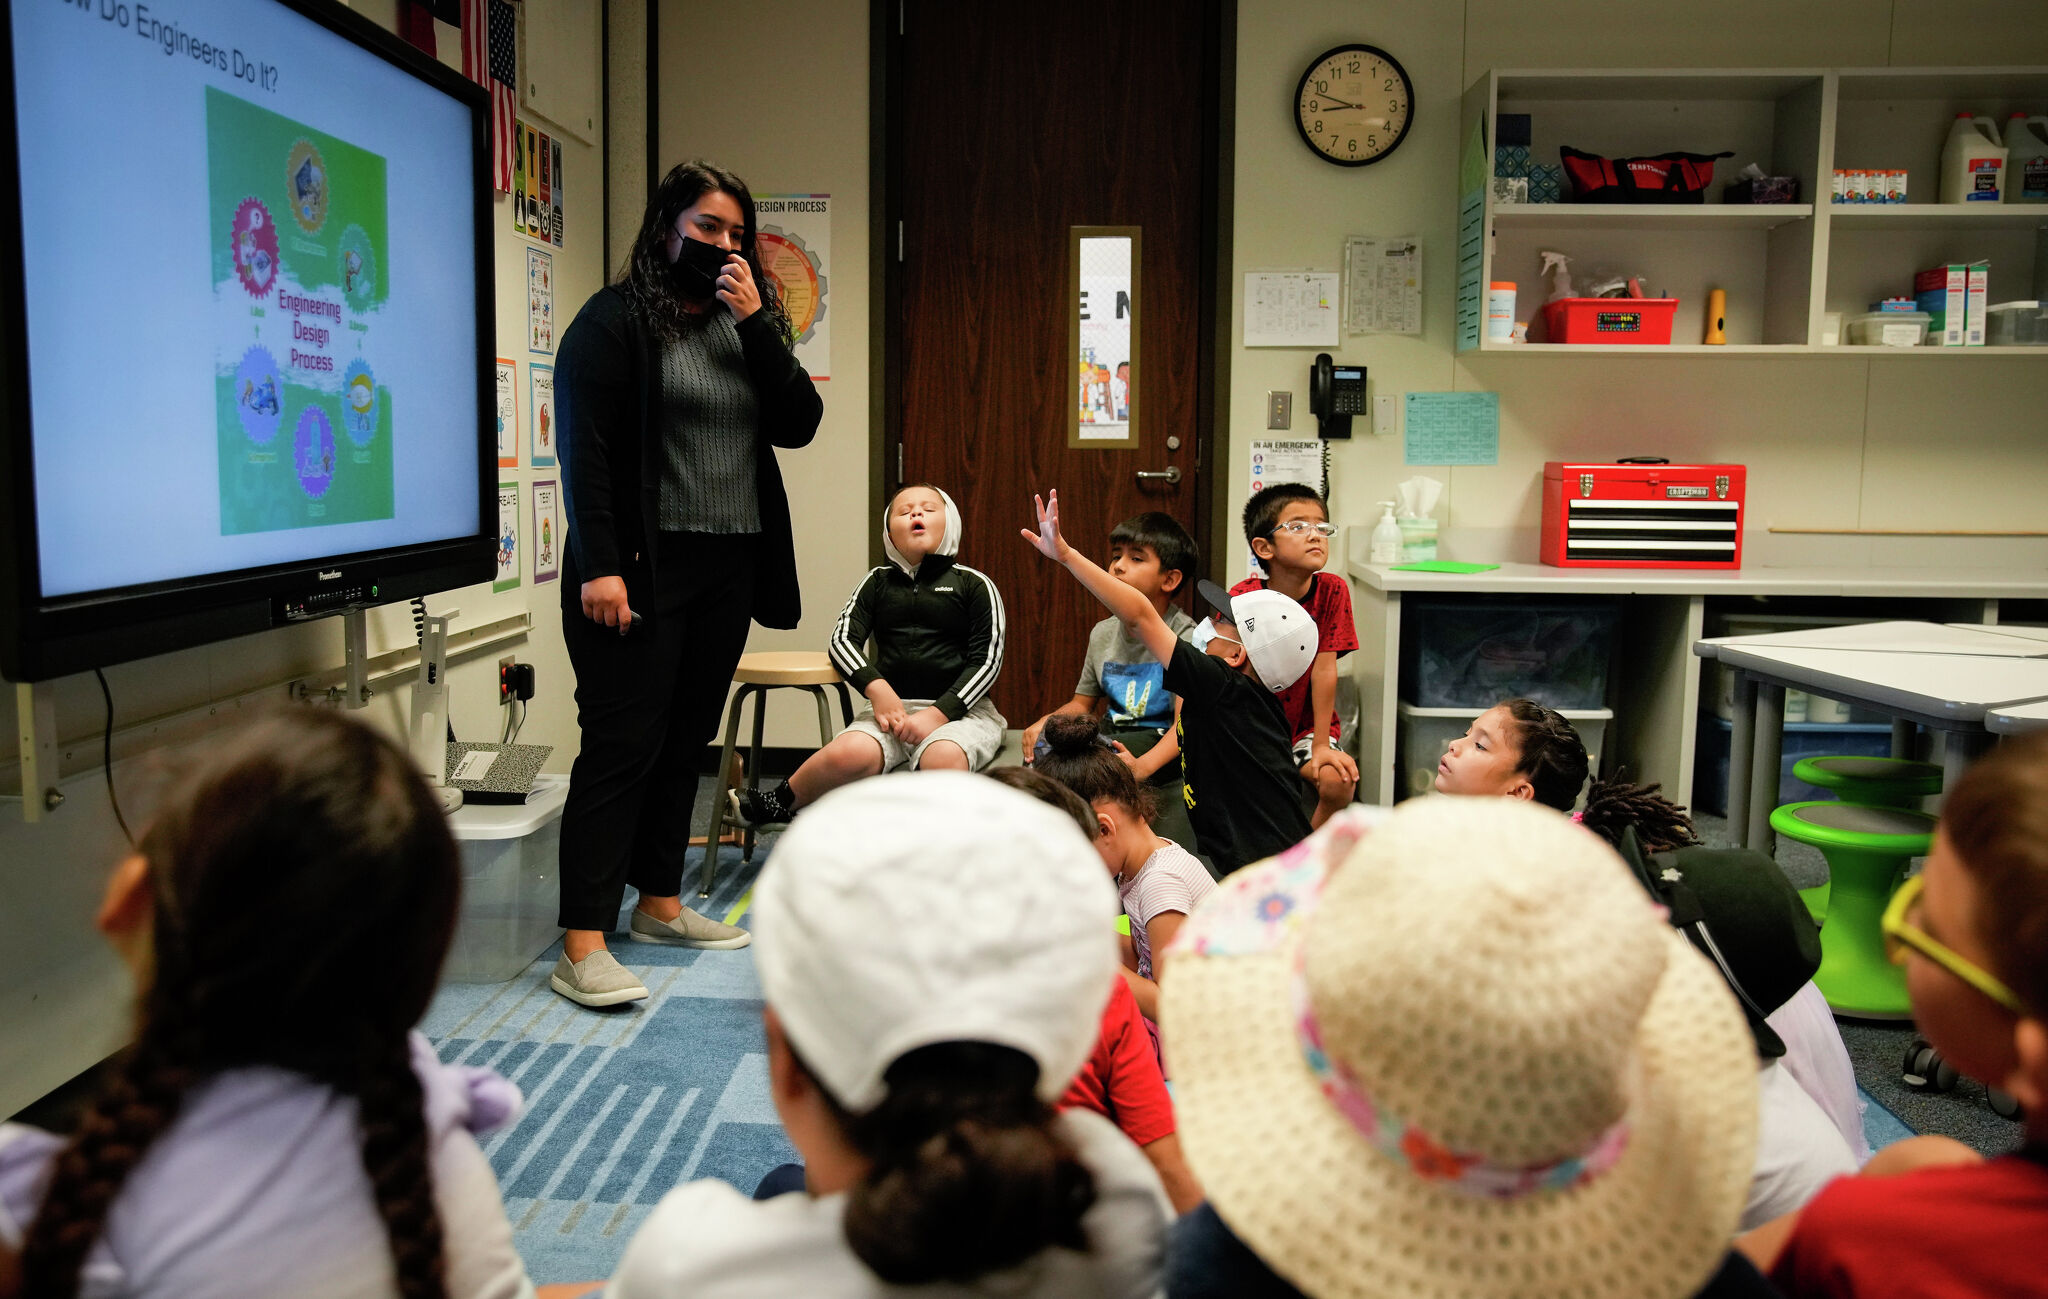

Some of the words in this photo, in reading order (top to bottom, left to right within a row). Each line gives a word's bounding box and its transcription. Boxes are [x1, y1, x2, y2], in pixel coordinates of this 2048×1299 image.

[136, 4, 228, 71] Engineers
[233, 49, 255, 84] Do
[260, 62, 279, 93] It?
[1330, 67, 1342, 80] 11
[1347, 61, 1361, 74] 12
[1315, 80, 1328, 94] 10
[1384, 79, 1393, 92] 2
[1309, 100, 1318, 113] 9
[1389, 100, 1398, 113] 3
[1314, 120, 1323, 133] 8
[1383, 120, 1392, 133] 4
[1330, 135, 1339, 148] 7
[1348, 139, 1357, 152] 6
[1367, 135, 1376, 148] 5
[754, 201, 785, 213] DESIGN
[788, 201, 827, 213] PROCESS
[279, 289, 341, 324] Engineering
[293, 320, 330, 348] Design
[291, 348, 334, 372] Process
[1253, 441, 1261, 449] IN
[1263, 441, 1273, 449] AN
[1274, 441, 1319, 449] EMERGENCY
[499, 494, 516, 506] REATE
[539, 492, 551, 504] TEST
[319, 570, 342, 581] Promethean
